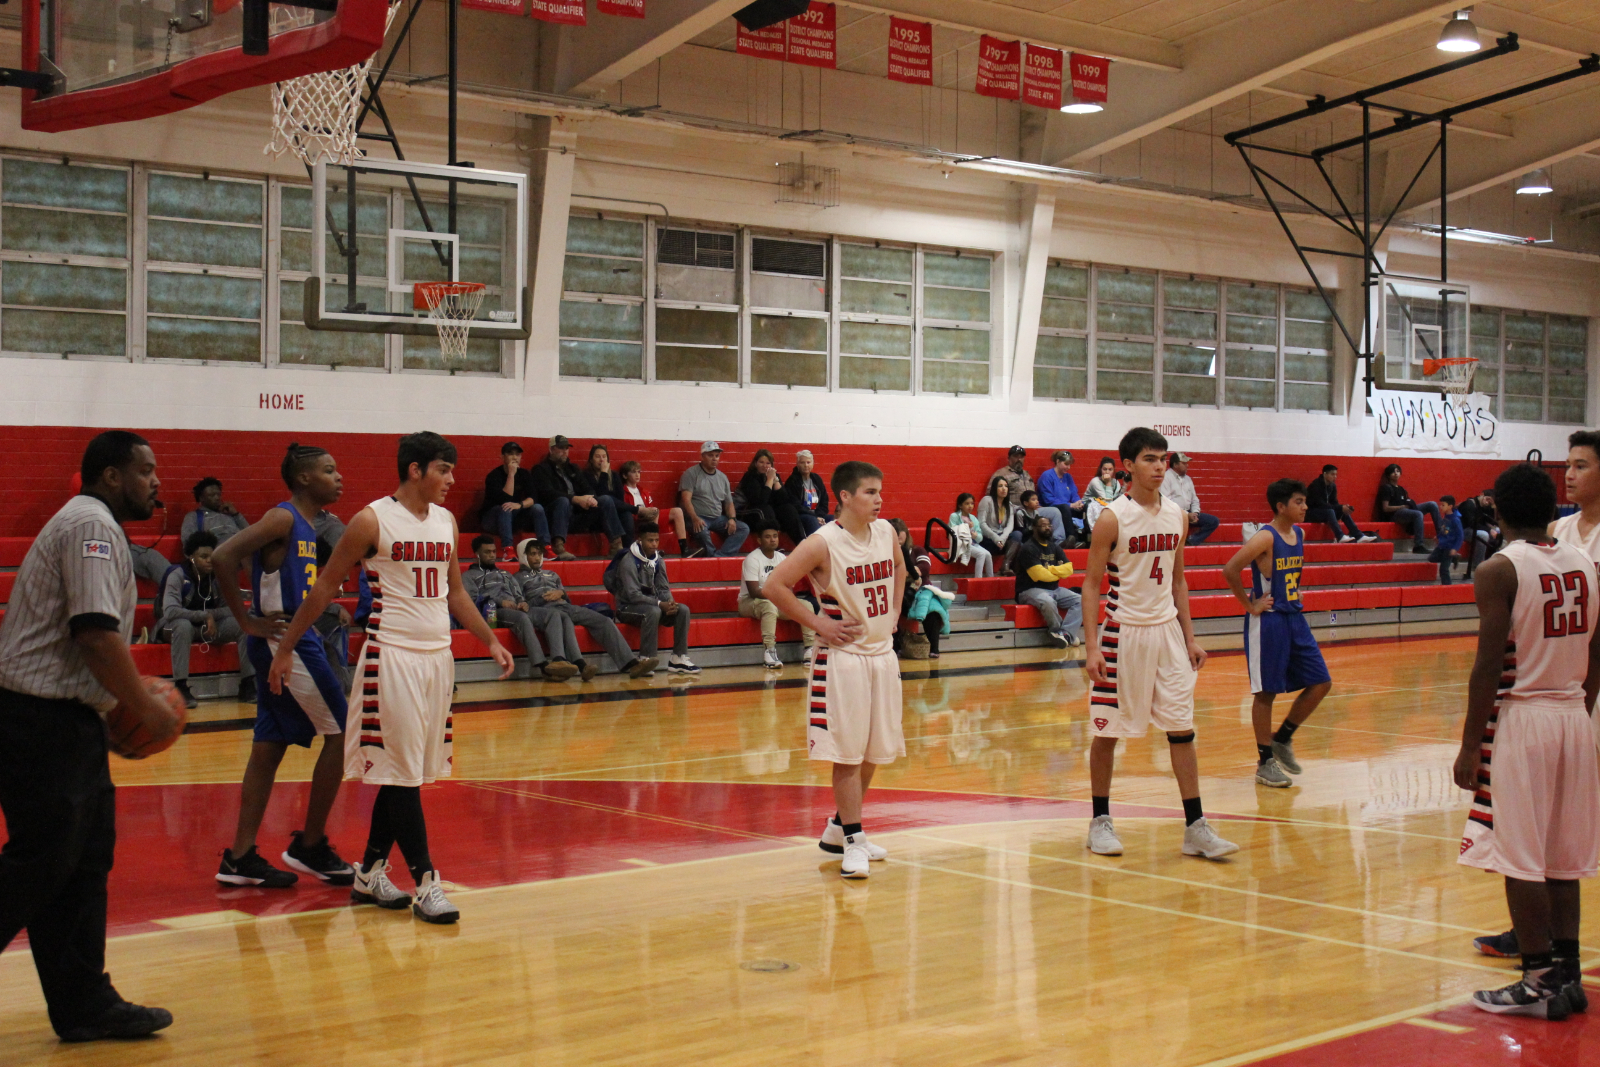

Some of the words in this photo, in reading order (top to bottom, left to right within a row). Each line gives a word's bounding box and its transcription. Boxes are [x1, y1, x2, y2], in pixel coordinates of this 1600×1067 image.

[532, 1, 547, 11] STATE
[548, 3, 583, 16] QUALIFIER
[790, 24, 806, 36] DISTRICT
[806, 28, 834, 40] CHAMPIONS
[894, 27, 920, 43] 1995
[739, 38, 753, 48] STATE
[754, 41, 784, 52] QUALIFIER
[791, 37, 811, 46] REGIONAL
[811, 41, 832, 49] MEDALIST
[890, 38, 903, 50] DISTRICT
[904, 42, 930, 54] CHAMPIONS
[790, 45, 805, 55] STATE
[806, 48, 833, 60] QUALIFIER
[985, 45, 1009, 61] 1997
[991, 63, 1019, 72] CHAMPIONS
[1028, 54, 1054, 68] 1998
[890, 64, 903, 74] STATE
[903, 67, 930, 78] QUALIFIER
[1037, 67, 1060, 79] CHAMPIONS
[1078, 63, 1100, 77] 1999
[988, 80, 1018, 90] QUALIFIER
[1028, 88, 1042, 98] STATE
[1042, 92, 1054, 101] 4TH
[259, 393, 304, 410] HOME
[1153, 424, 1191, 436] STUDENTS
[1379, 396, 1495, 448] JUNIORS
[391, 541, 452, 562] SHARKS
[1128, 533, 1180, 554] SHARKS
[846, 559, 893, 585] SHARKS
[1149, 556, 1163, 585] 4
[412, 567, 438, 598] 10
[863, 585, 889, 618] 33
[1538, 570, 1589, 638] 23
